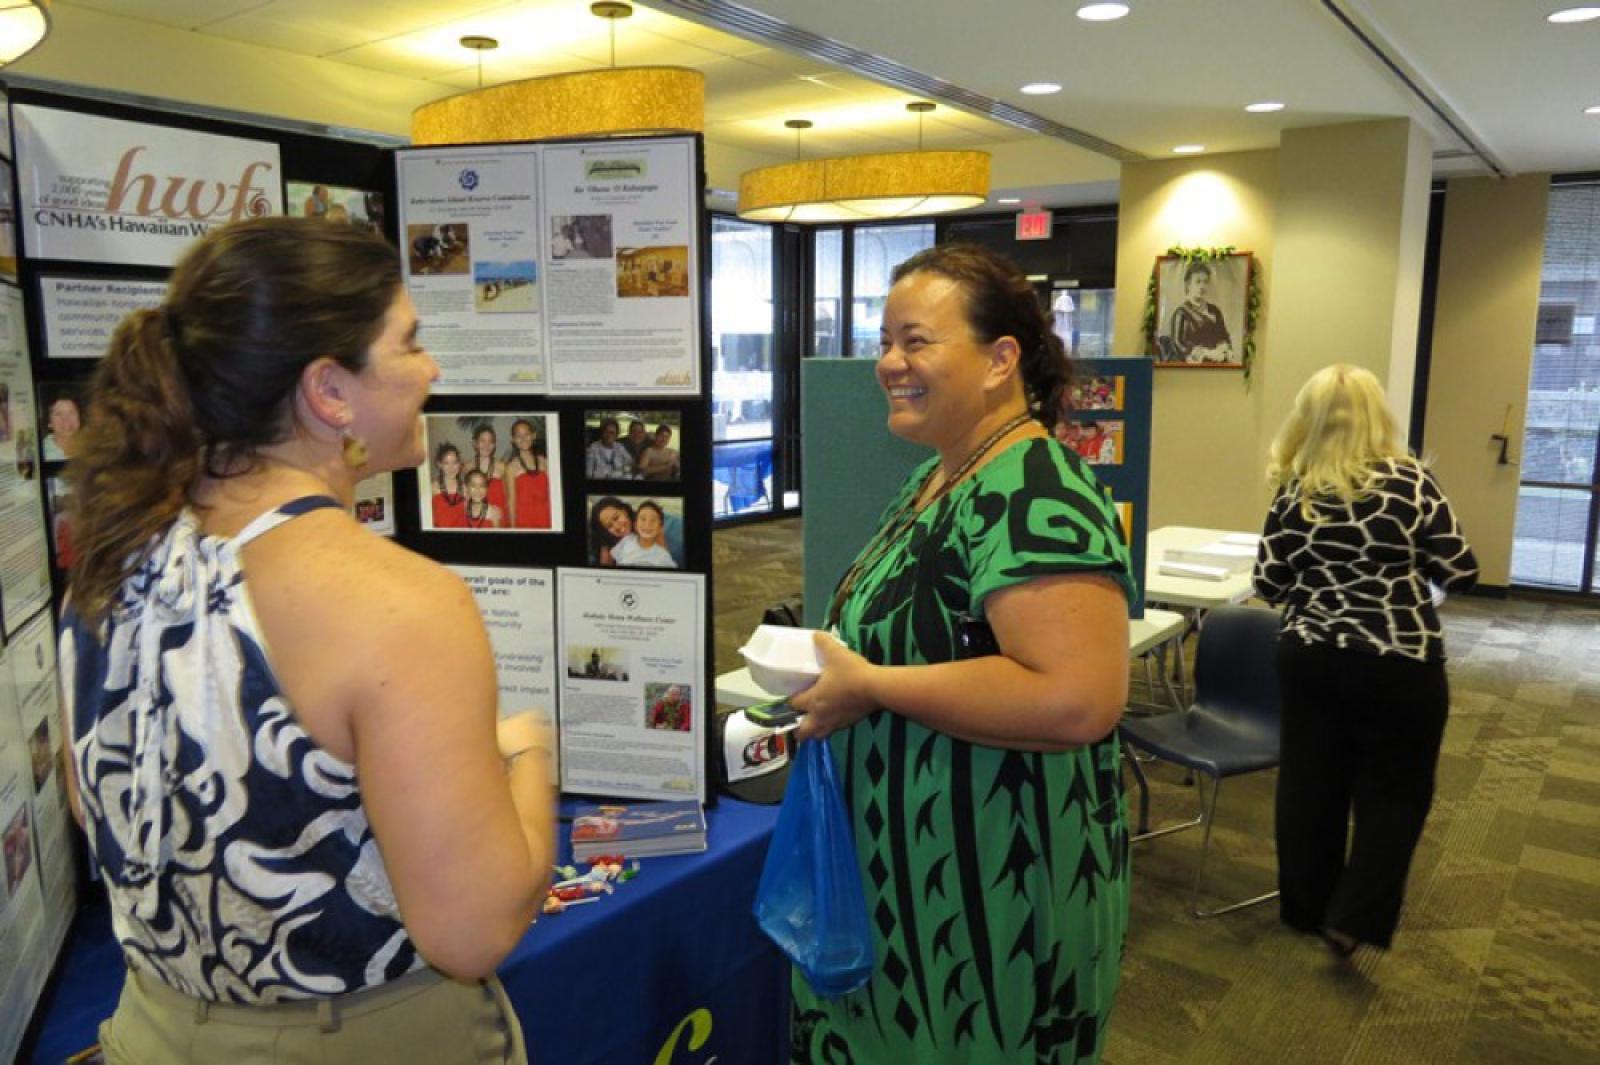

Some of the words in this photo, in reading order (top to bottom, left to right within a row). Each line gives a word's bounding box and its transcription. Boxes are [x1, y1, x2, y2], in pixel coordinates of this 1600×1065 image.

[34, 209, 107, 231] CNHA's
[109, 213, 188, 236] Hawaiian
[56, 281, 102, 293] Partner
[488, 576, 513, 587] goals
[516, 577, 526, 586] of
[528, 577, 545, 587] the
